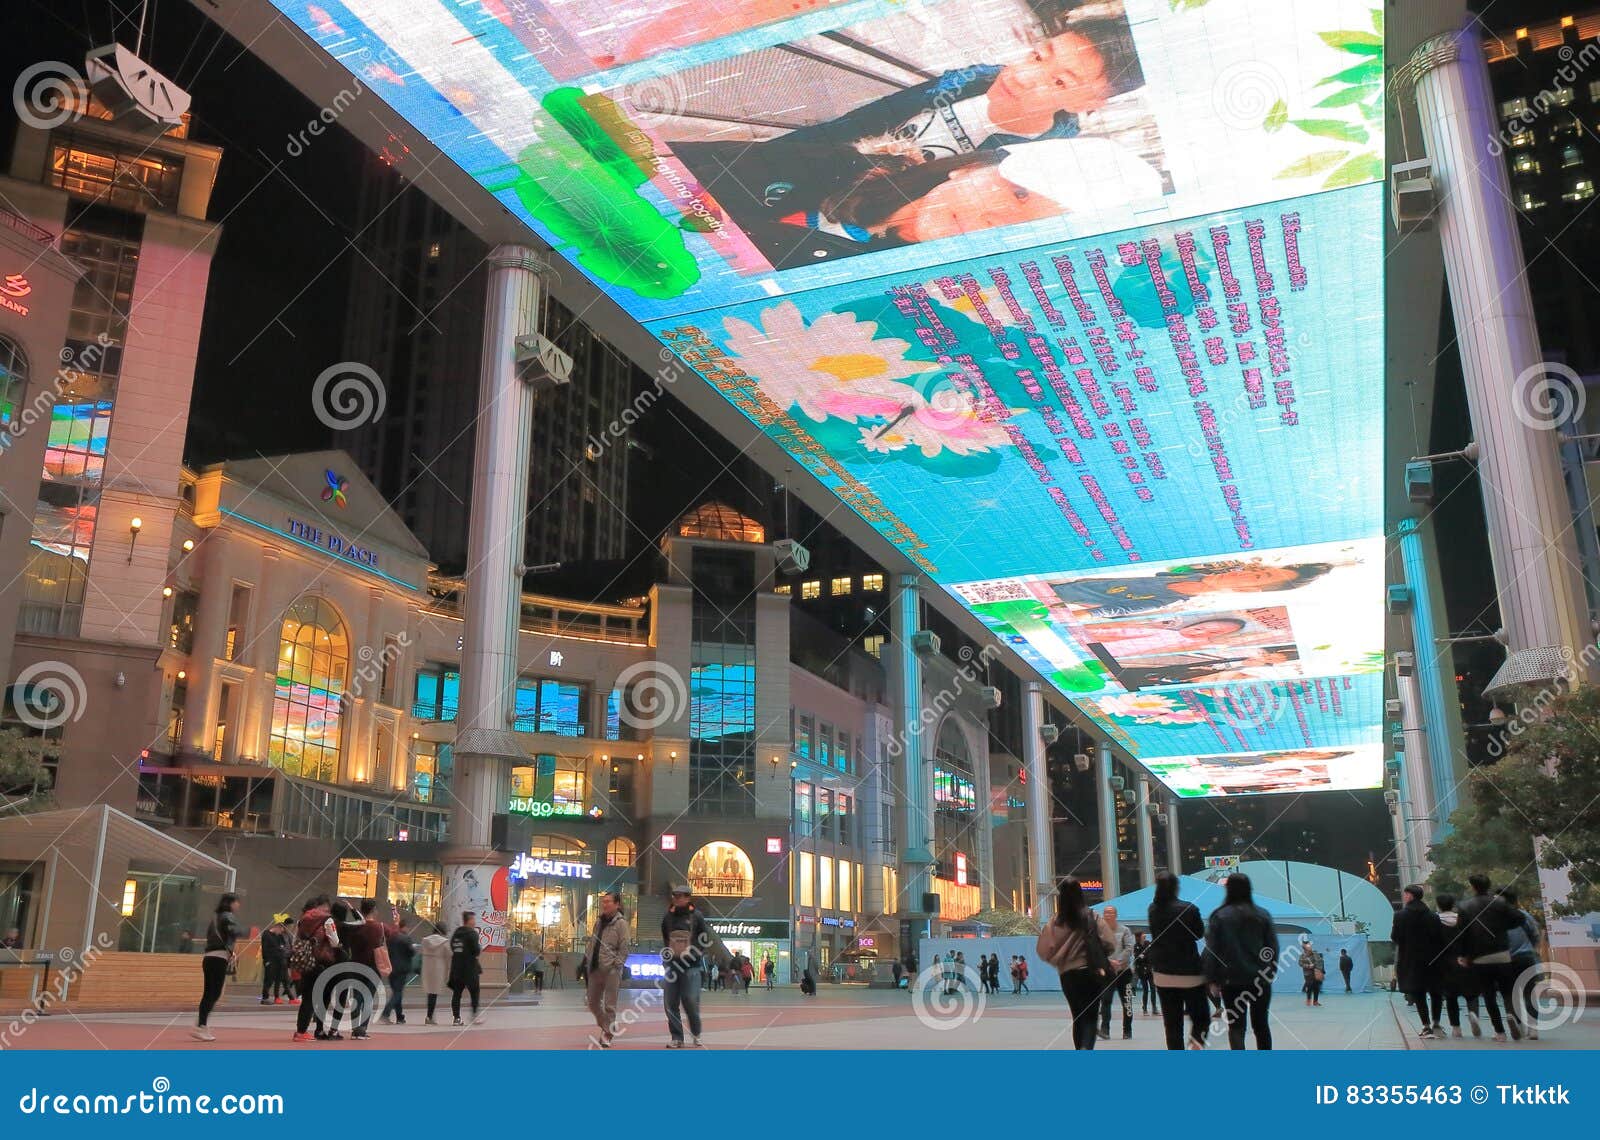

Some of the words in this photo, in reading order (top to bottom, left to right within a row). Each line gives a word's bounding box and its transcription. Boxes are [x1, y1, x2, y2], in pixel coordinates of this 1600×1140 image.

[689, 197, 731, 240] together
[287, 518, 324, 545] THE
[328, 534, 378, 568] PLACE
[524, 856, 592, 880] BAGUETTE
